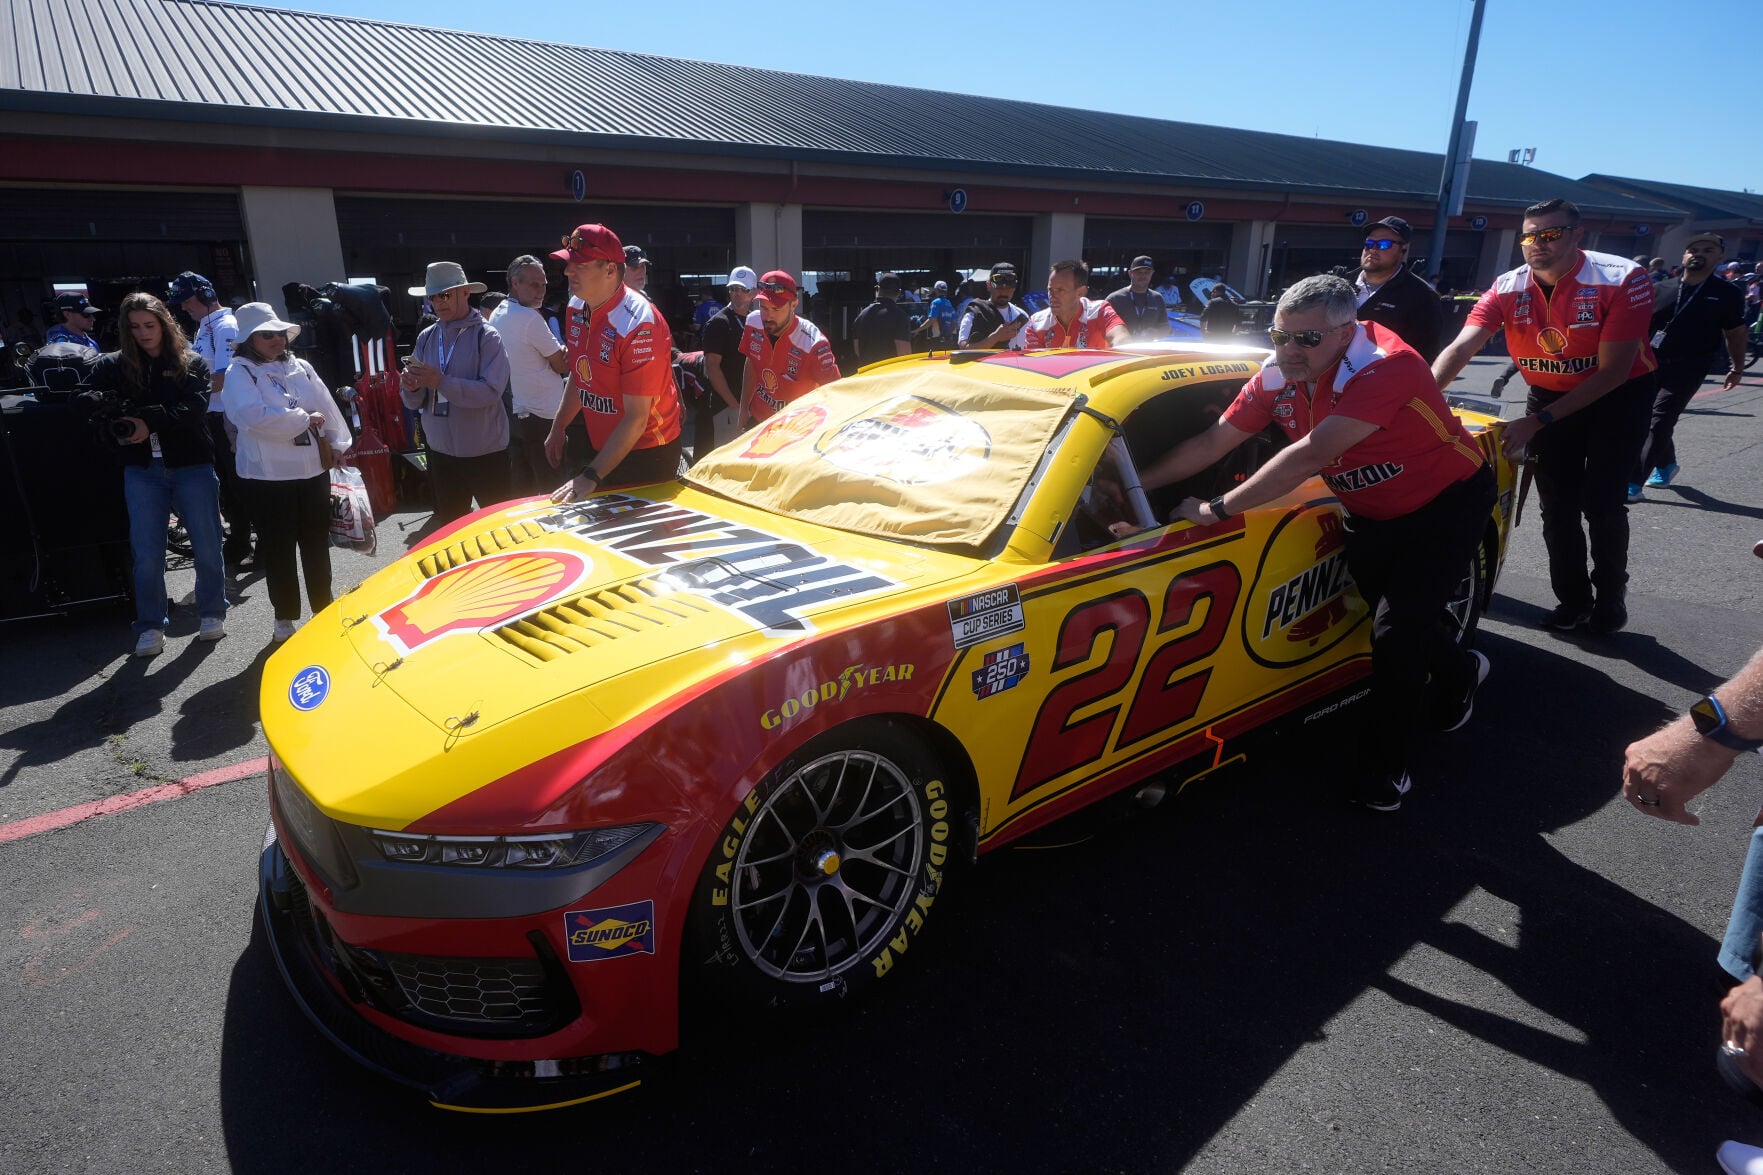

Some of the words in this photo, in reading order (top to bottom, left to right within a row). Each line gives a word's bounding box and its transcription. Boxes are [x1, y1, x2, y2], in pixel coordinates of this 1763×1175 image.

[1191, 204, 1200, 214] 11
[1161, 367, 1195, 381] JOEY
[1198, 362, 1250, 376] LOGANO
[972, 589, 1009, 613] NASCAR
[963, 617, 981, 636] CUP
[982, 608, 1013, 630] SERIES
[986, 658, 1017, 684] 250
[1009, 560, 1242, 804] 22
[293, 670, 324, 704] Ford
[760, 662, 916, 732] GOODYEAR
[1303, 703, 1339, 725] FORD
[711, 788, 762, 907] EAGLE
[573, 921, 648, 945] SUNOCO
